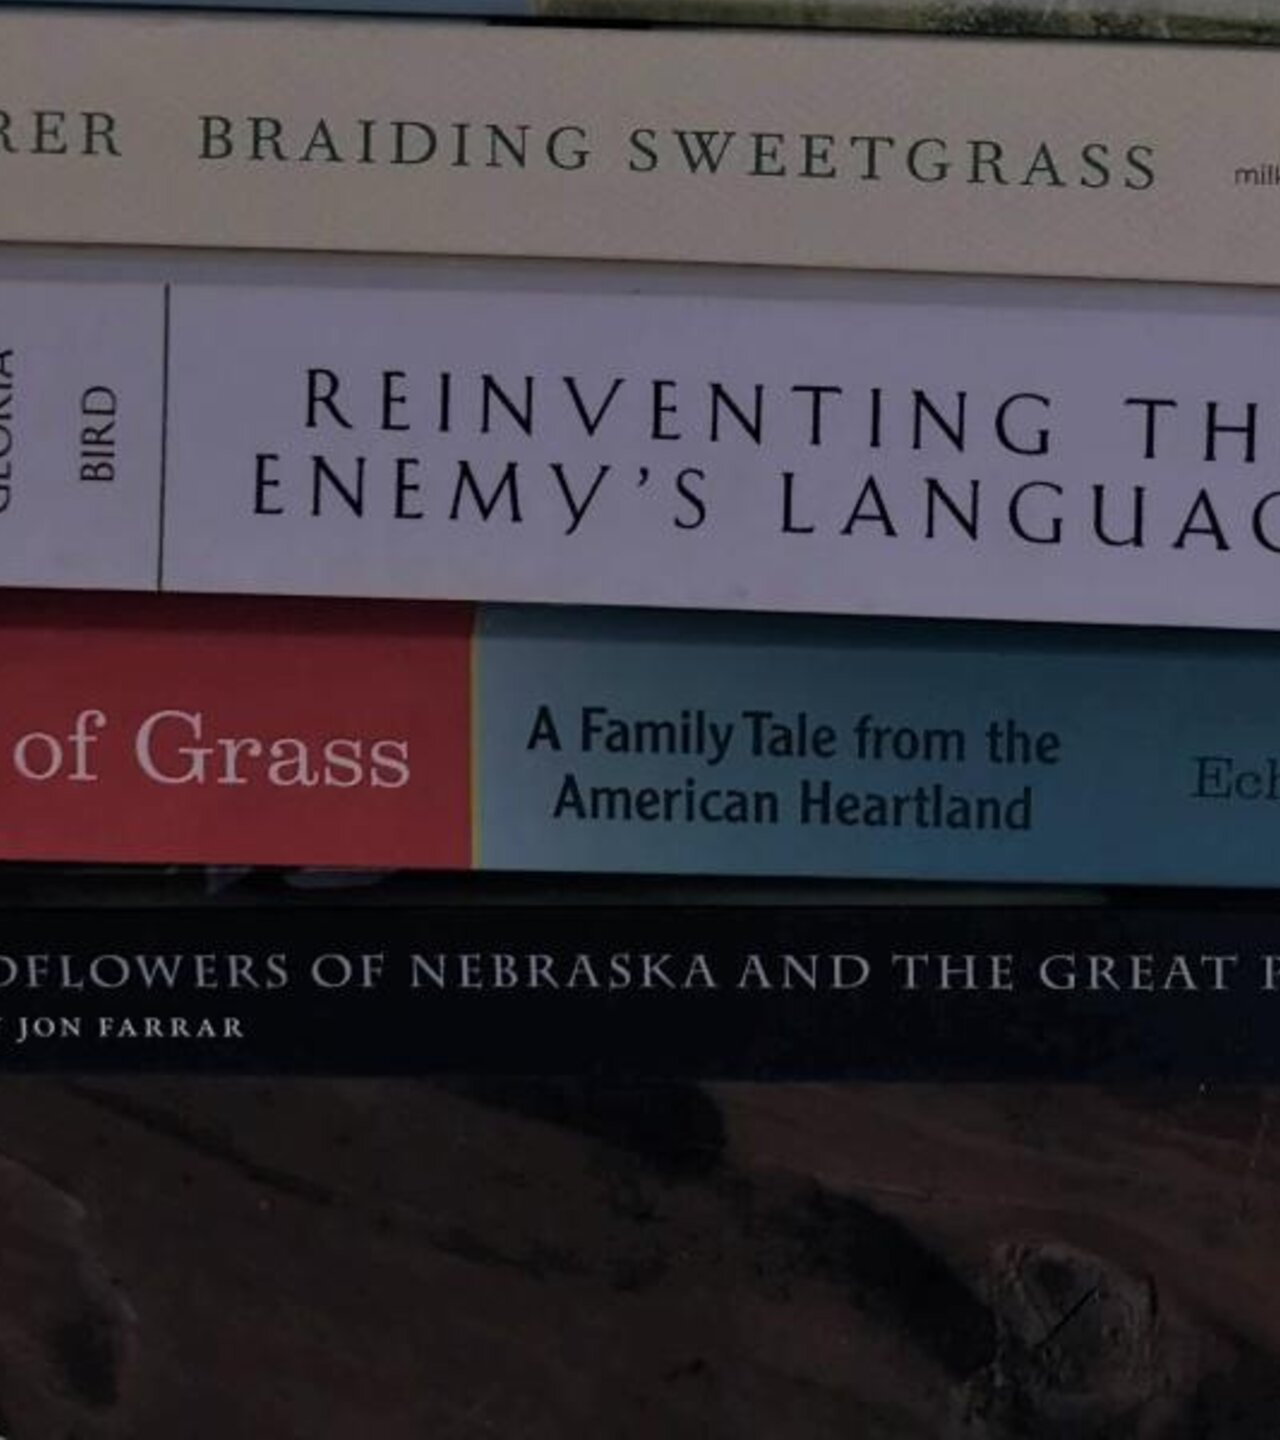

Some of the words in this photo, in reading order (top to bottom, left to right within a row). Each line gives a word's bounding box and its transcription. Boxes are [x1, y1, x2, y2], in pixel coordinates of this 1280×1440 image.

[199, 117, 593, 172] BRAIDING
[628, 128, 1157, 191] SWEETGRASS
[81, 387, 117, 483] BIRD
[306, 368, 1052, 457] REINVENTING
[14, 710, 105, 782] of
[135, 708, 410, 788] Grass
[529, 707, 560, 751] A
[583, 709, 732, 765] Family
[743, 711, 837, 759] Tale
[854, 714, 965, 762] from
[986, 721, 1060, 765] the
[552, 774, 779, 825] American
[799, 778, 1032, 831] Heartland
[311, 954, 385, 989] OF
[410, 953, 717, 991] NEBRASKA
[737, 952, 870, 990] AND
[893, 953, 1014, 991] THE
[1037, 953, 1238, 991] GREAT
[16, 1016, 82, 1044] JON
[98, 1016, 245, 1039] FARRAR
